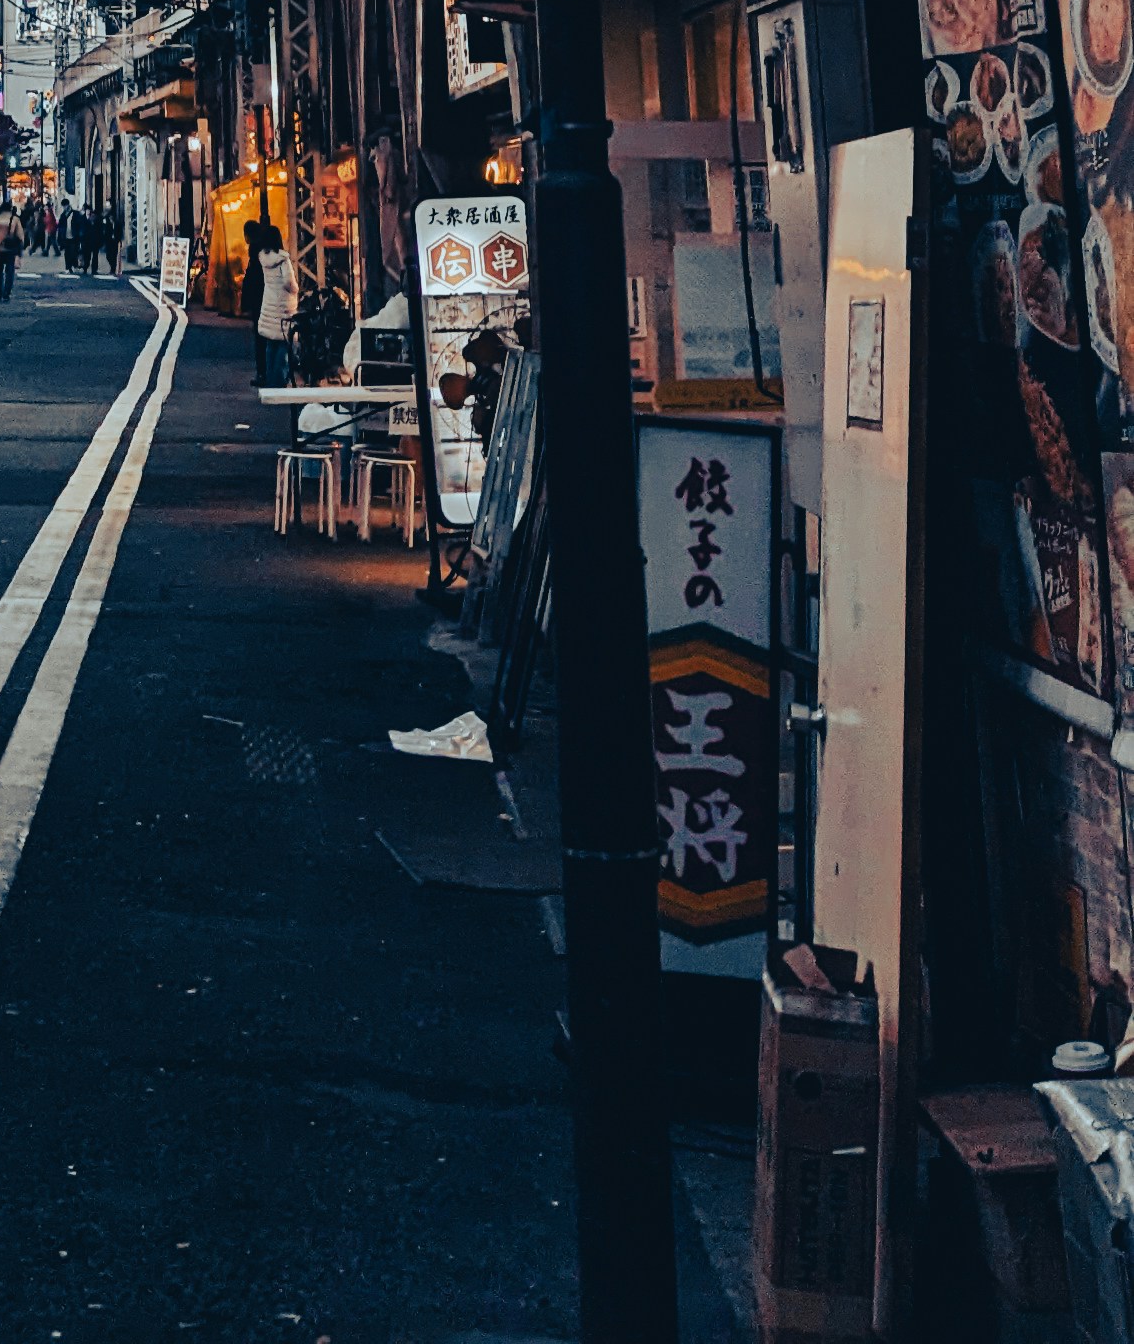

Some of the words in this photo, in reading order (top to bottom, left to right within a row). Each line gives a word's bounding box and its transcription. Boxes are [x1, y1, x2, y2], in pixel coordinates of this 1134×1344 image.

[428, 204, 521, 227] 大衆居酒屋
[675, 457, 735, 609] 餃子の
[655, 687, 749, 884] 王将
